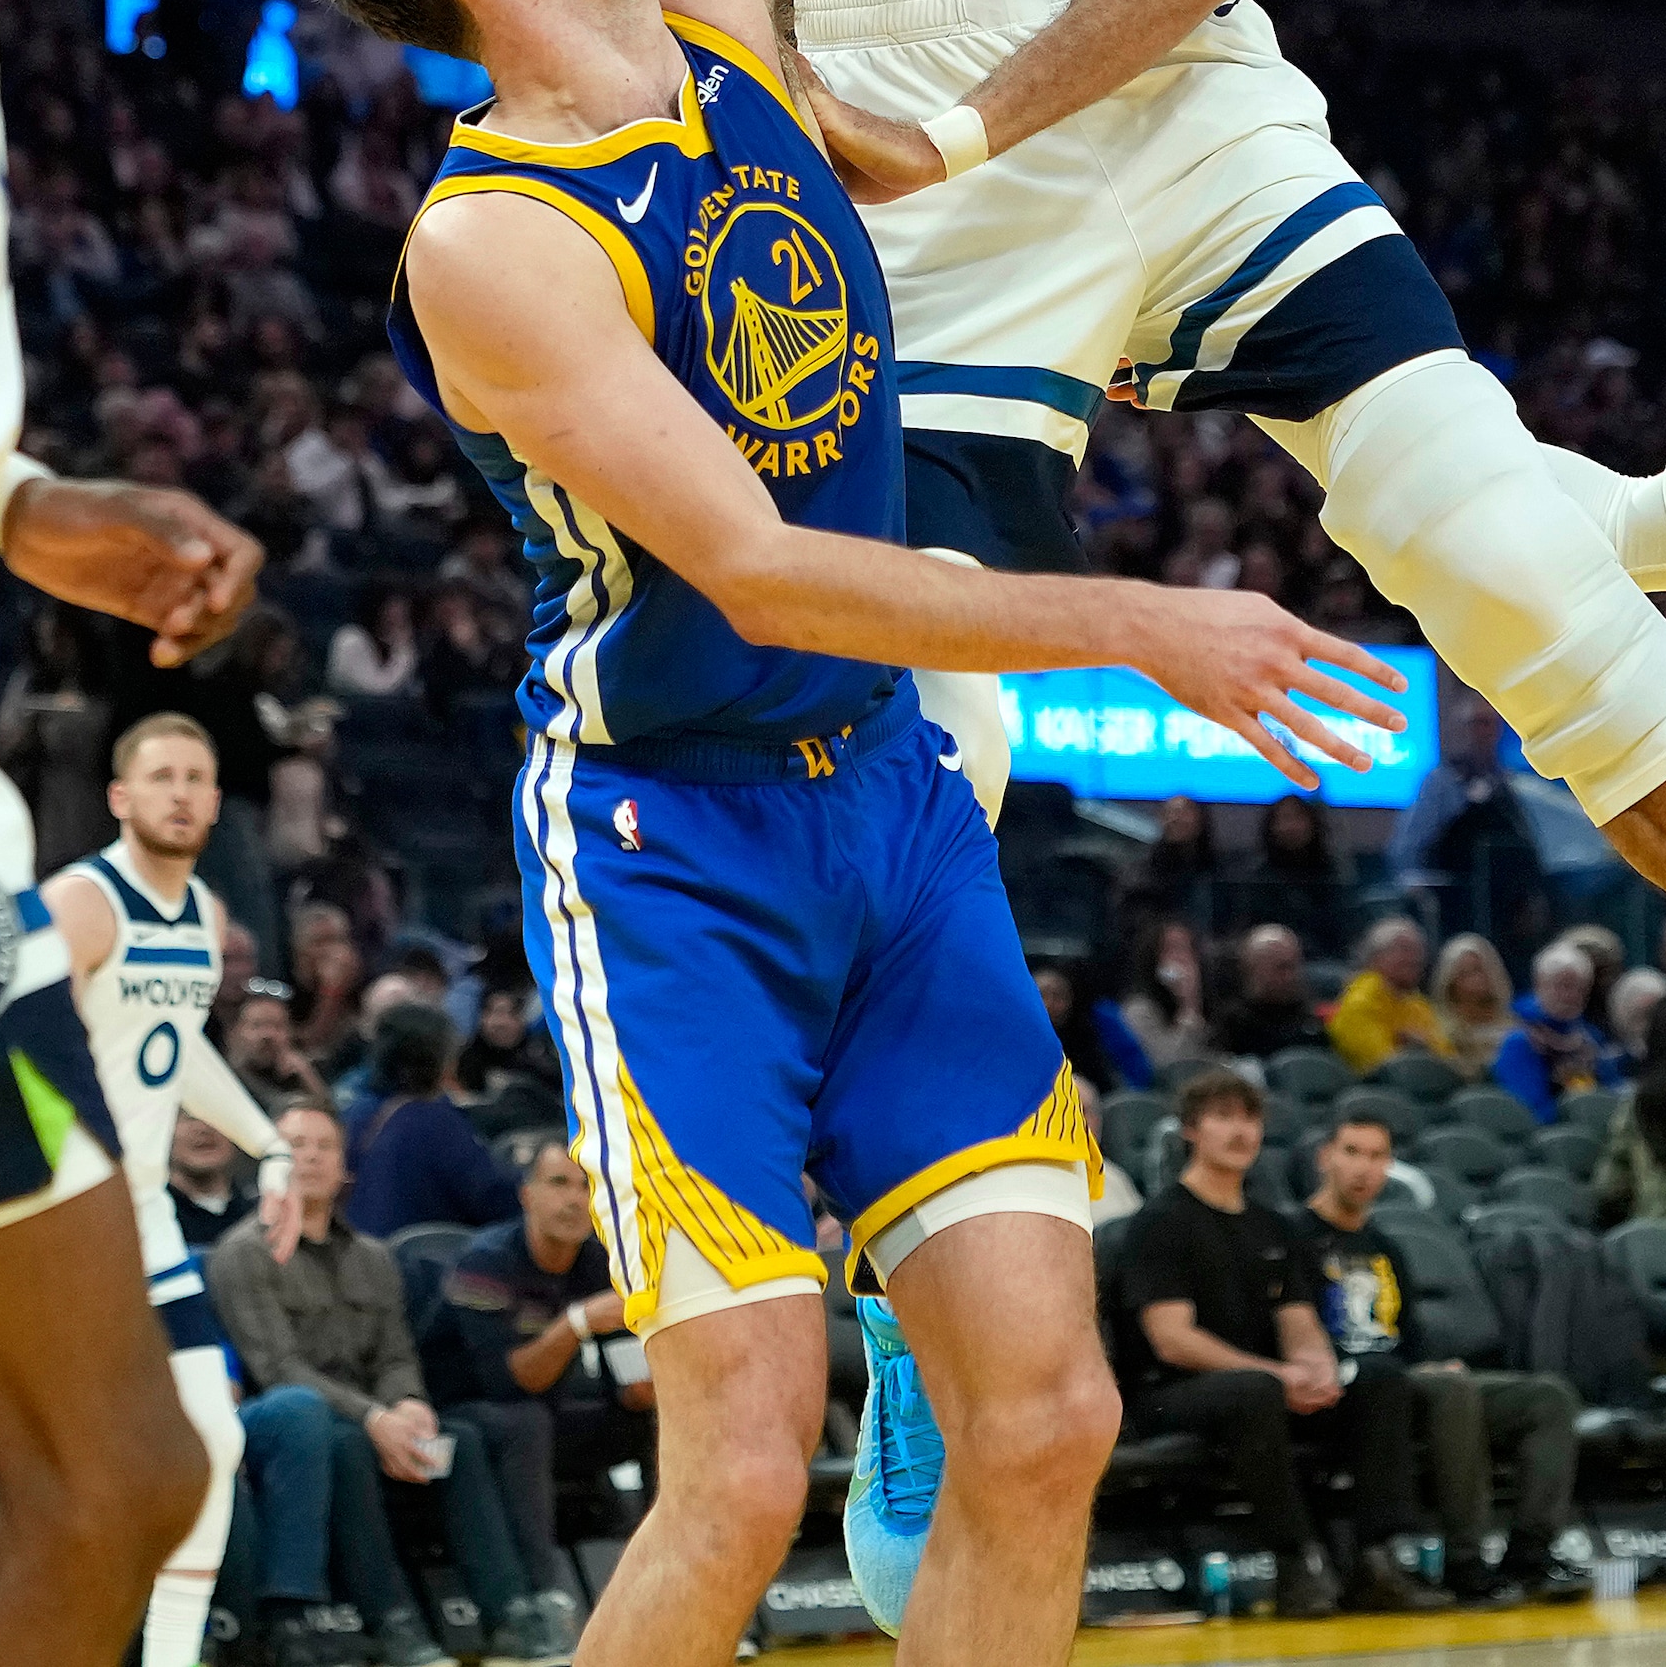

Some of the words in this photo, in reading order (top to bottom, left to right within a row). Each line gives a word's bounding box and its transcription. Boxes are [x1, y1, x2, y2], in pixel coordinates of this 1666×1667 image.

[731, 165, 800, 201] TATE
[771, 228, 823, 305] 21
[726, 332, 880, 478] WARRORS
[138, 1021, 179, 1087] 0
